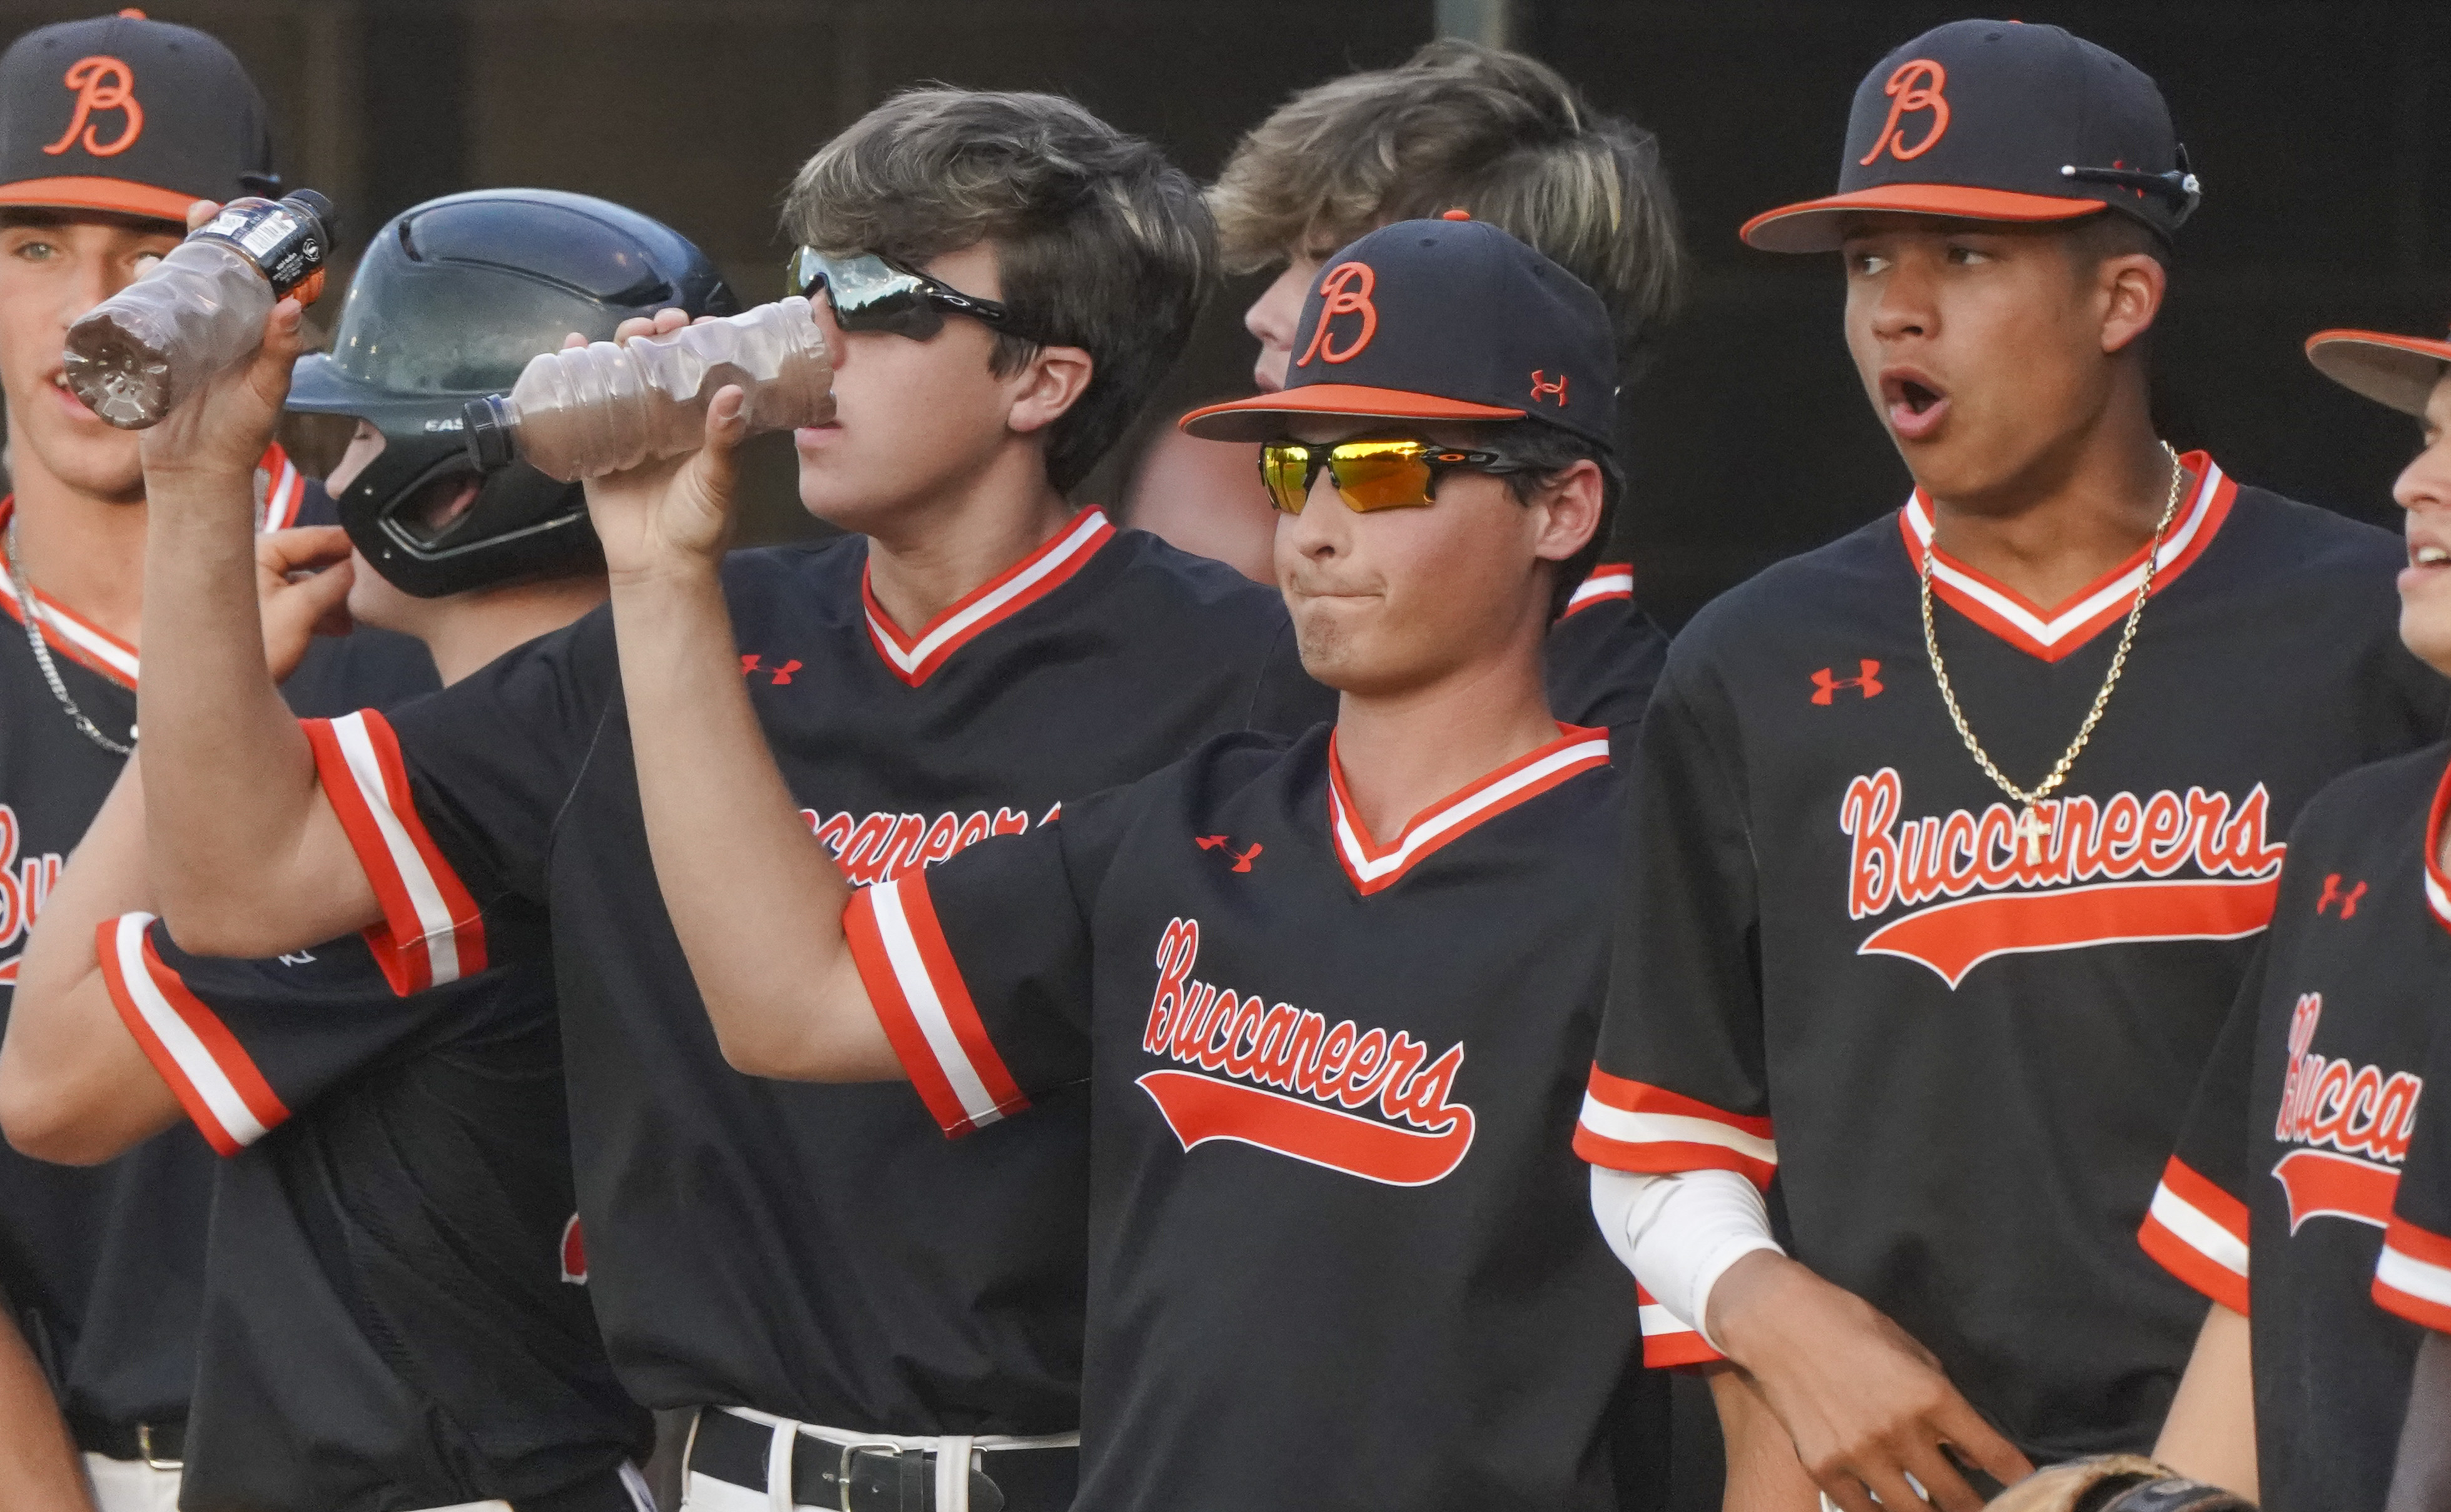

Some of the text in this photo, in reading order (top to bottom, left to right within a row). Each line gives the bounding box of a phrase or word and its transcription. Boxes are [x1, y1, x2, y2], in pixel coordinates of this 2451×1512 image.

[42, 54, 145, 157] B
[1859, 58, 1952, 167] B
[1296, 261, 1378, 368] B
[1840, 766, 2287, 921] Buccaneers
[1142, 916, 1470, 1131] Buccaneers
